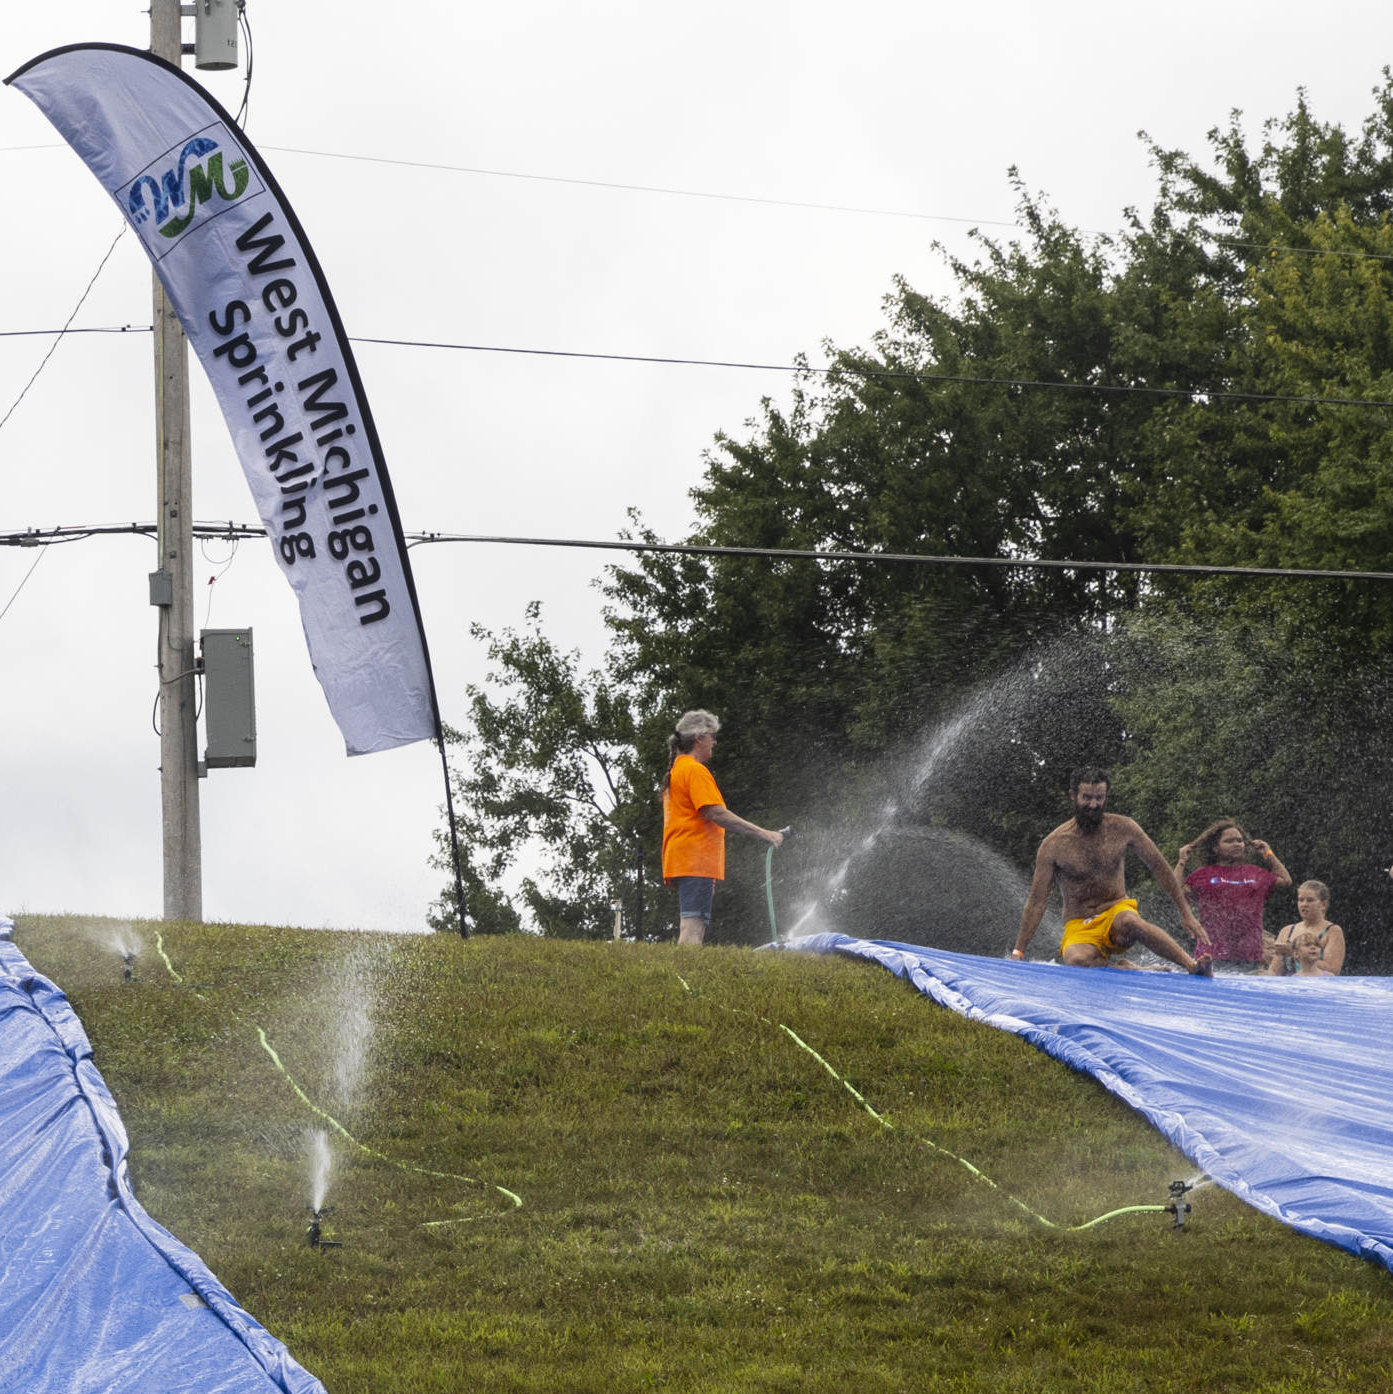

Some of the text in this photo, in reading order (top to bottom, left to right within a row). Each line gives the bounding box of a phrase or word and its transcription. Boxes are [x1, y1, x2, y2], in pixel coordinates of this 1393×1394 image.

[207, 299, 318, 567] Sprinkling
[235, 211, 392, 628] West Michigan
